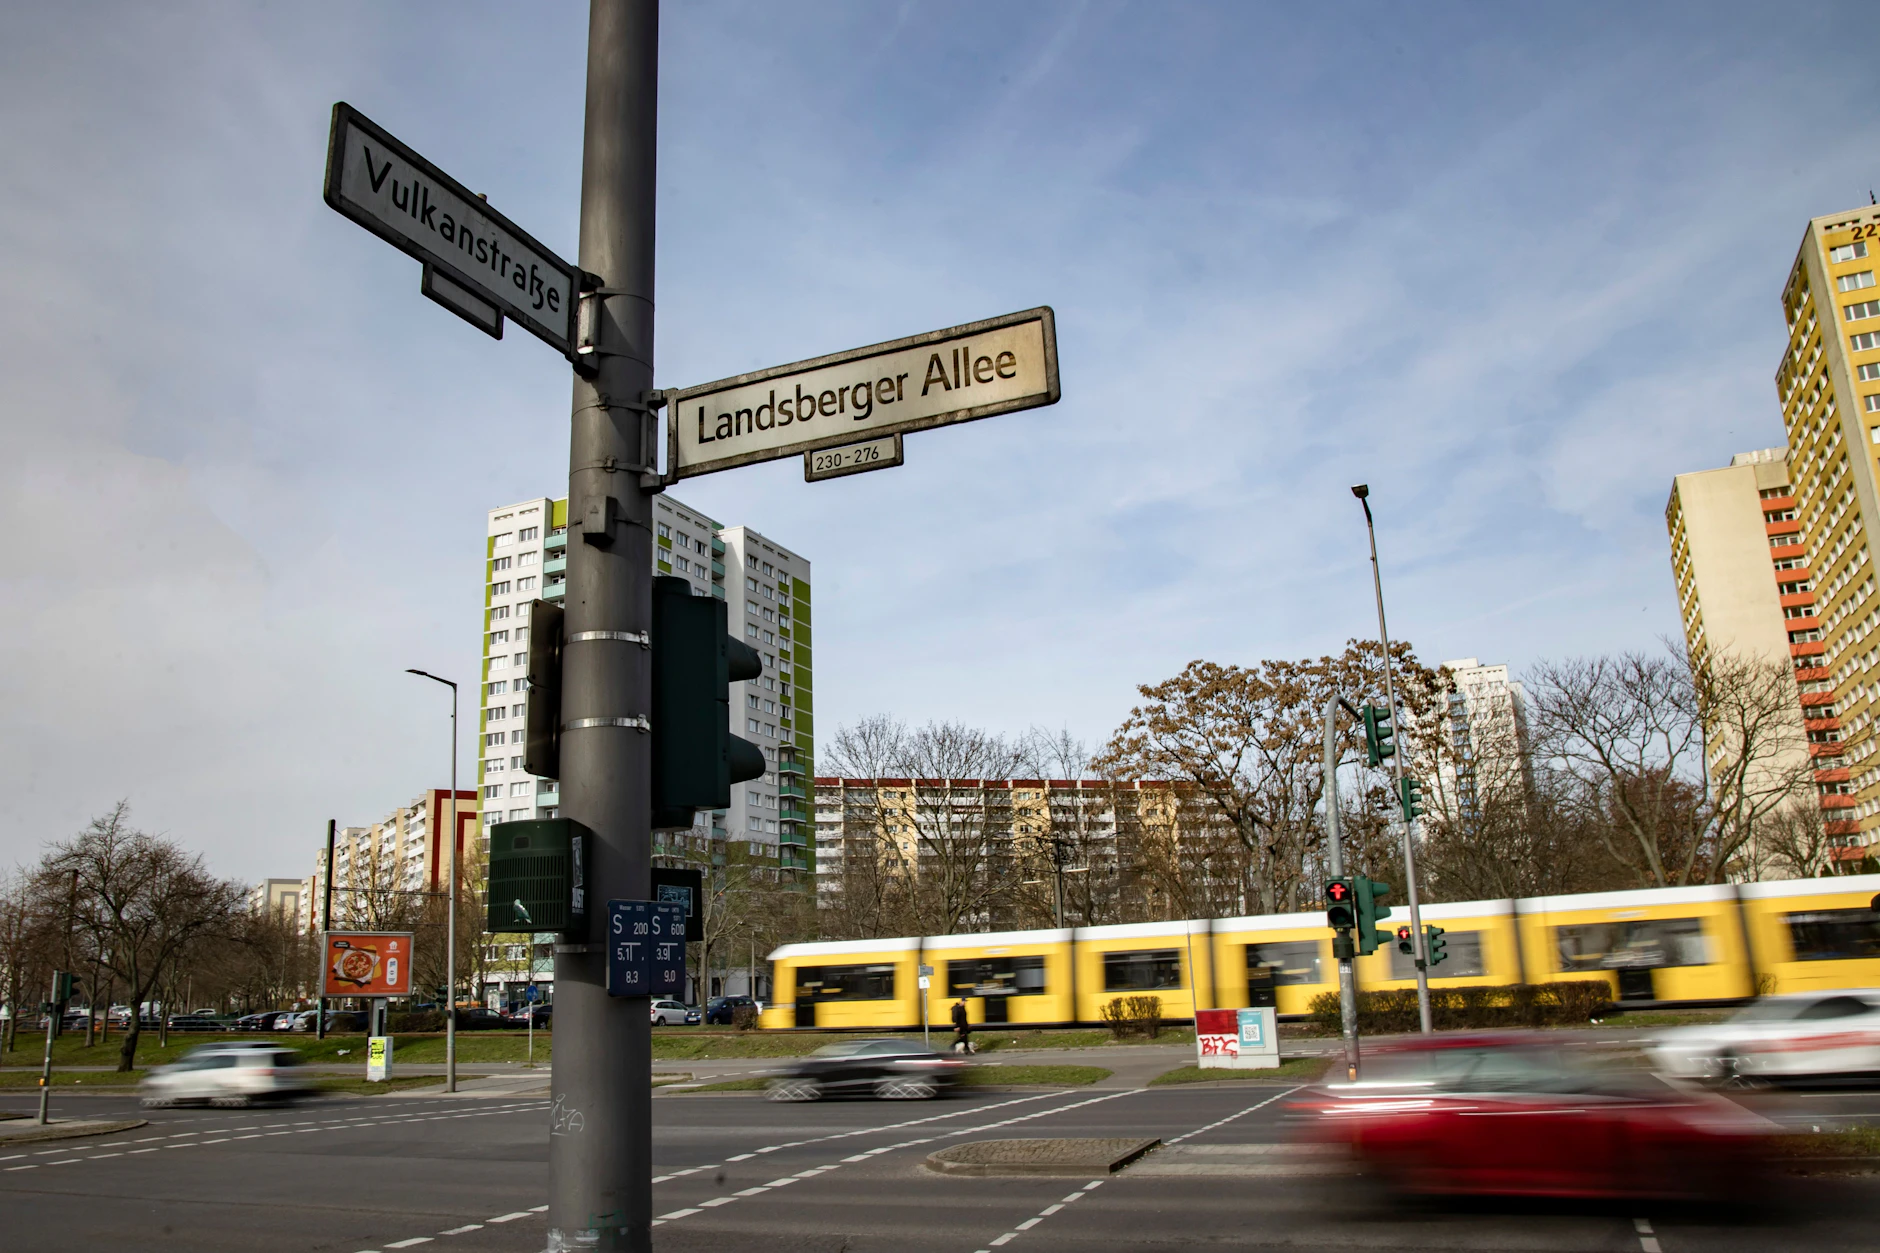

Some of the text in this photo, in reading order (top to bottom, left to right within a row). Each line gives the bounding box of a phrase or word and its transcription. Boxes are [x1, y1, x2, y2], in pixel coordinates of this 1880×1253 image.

[363, 145, 560, 313] Vulkanstraße
[1851, 222, 1880, 241] 22
[698, 346, 1017, 445] Landsberger Allee
[613, 914, 648, 935] S 200
[652, 915, 660, 935] S
[671, 923, 685, 936] 600
[626, 970, 638, 984] 8,3
